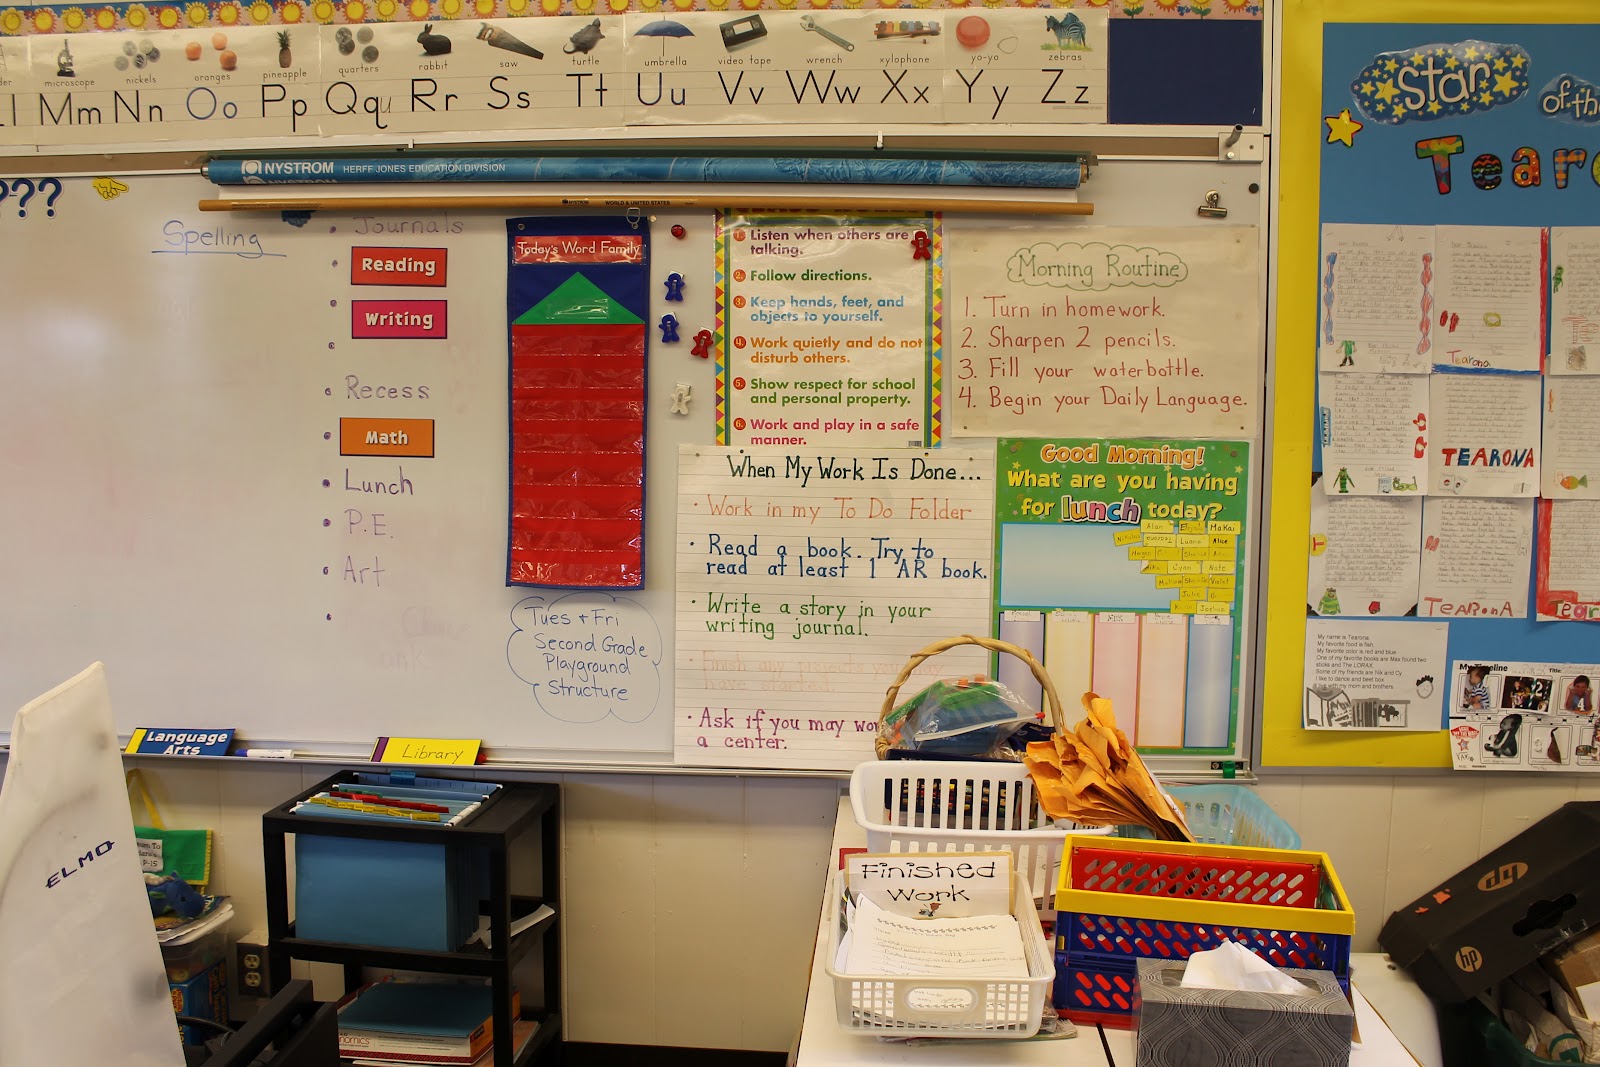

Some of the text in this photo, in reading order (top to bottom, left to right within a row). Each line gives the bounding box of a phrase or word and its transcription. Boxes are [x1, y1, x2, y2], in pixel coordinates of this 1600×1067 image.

[418, 61, 448, 71] rabbit
[499, 60, 518, 68] saw
[572, 56, 600, 66] turtle
[644, 56, 687, 67] umbrella
[718, 55, 772, 68] video tape
[806, 54, 843, 64] wrench
[879, 55, 930, 67] xylophone
[970, 53, 1000, 65] yo-yo
[1048, 52, 1082, 62] zebras
[194, 73, 231, 83] oranges
[263, 69, 307, 81] pineapple
[338, 64, 379, 76] quarters
[44, 78, 95, 89] microscope
[126, 75, 157, 85] nickels
[1398, 57, 1600, 118] Star of th
[264, 161, 506, 175] NYSTROM HERFF JONES EDUCATION DIVISION
[1415, 135, 1600, 195] Tear
[353, 212, 464, 235] Journals
[162, 220, 264, 258] Spelling
[750, 229, 909, 241] Listen when others are
[518, 240, 640, 260] Today's Word Family
[750, 243, 803, 257] talking.
[362, 257, 436, 277] Reading
[750, 269, 872, 281] Follow directions.
[1018, 254, 1180, 287] Morning Routine
[750, 295, 904, 311] Keep hands, feet, and
[964, 295, 1165, 318] 1. Turn in homework.
[365, 311, 434, 330] Writing
[750, 309, 883, 325] objects to yourself.
[960, 325, 1176, 355] 2. Sharpen 2 pencils.
[1446, 349, 1491, 367] Tearona
[345, 374, 430, 400] Recess
[750, 378, 916, 394] Show respect for school
[750, 393, 911, 408] and personal property.
[959, 385, 1247, 415] 4. Begin your Daily Language.
[365, 430, 409, 445] Math
[1041, 444, 1205, 469] Good Morning!
[1442, 447, 1535, 468] TEARONA
[345, 466, 414, 495] Lunch
[727, 455, 775, 480] When
[785, 456, 812, 488] My
[817, 456, 865, 482] Work
[872, 457, 899, 480] Is
[1007, 470, 1238, 495] What are you having
[707, 494, 972, 525] Work in my To Do Folder
[1021, 496, 1224, 523] for lunch today?
[344, 508, 394, 538] P.E.
[708, 534, 934, 563] Read a book. Try to
[343, 556, 385, 587] Art
[706, 554, 987, 580] read at least 1 AR book.
[524, 605, 571, 626] Tues
[590, 608, 619, 626] Fri
[534, 633, 649, 659] Second Grade
[543, 653, 631, 679] Playground
[548, 679, 629, 701] Structure
[147, 731, 228, 746] Language
[163, 744, 201, 755] Arts
[401, 744, 464, 764] Library
[45, 840, 115, 888] ELMO
[861, 861, 996, 880] Finished
[886, 885, 970, 902] Work
[1456, 947, 1481, 972] hp
